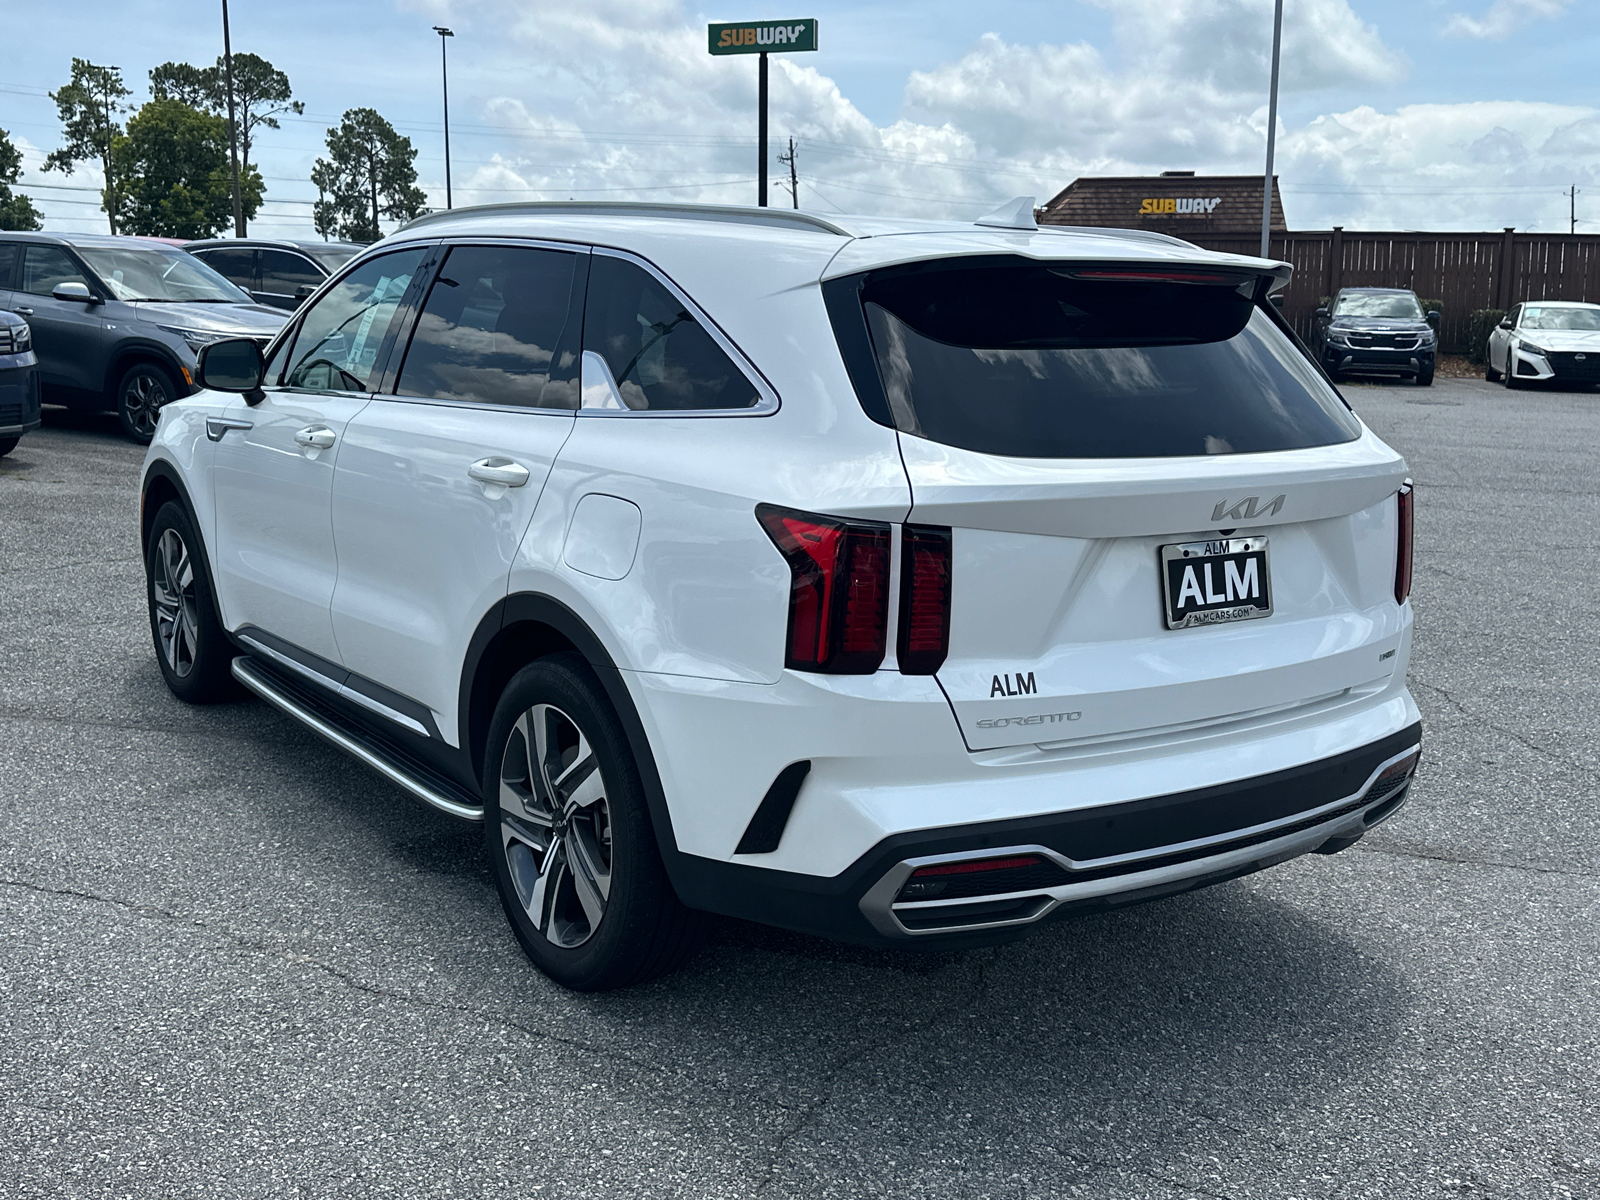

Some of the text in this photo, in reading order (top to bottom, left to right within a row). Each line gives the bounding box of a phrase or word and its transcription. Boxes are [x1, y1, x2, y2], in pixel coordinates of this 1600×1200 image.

[718, 24, 805, 47] SUBWAY
[1139, 197, 1221, 214] SUBWAY
[1211, 493, 1286, 521] KIA
[1204, 541, 1230, 555] ALM
[1177, 557, 1260, 609] ALM
[990, 672, 1037, 698] ALM
[976, 711, 1082, 728] SORENTO
